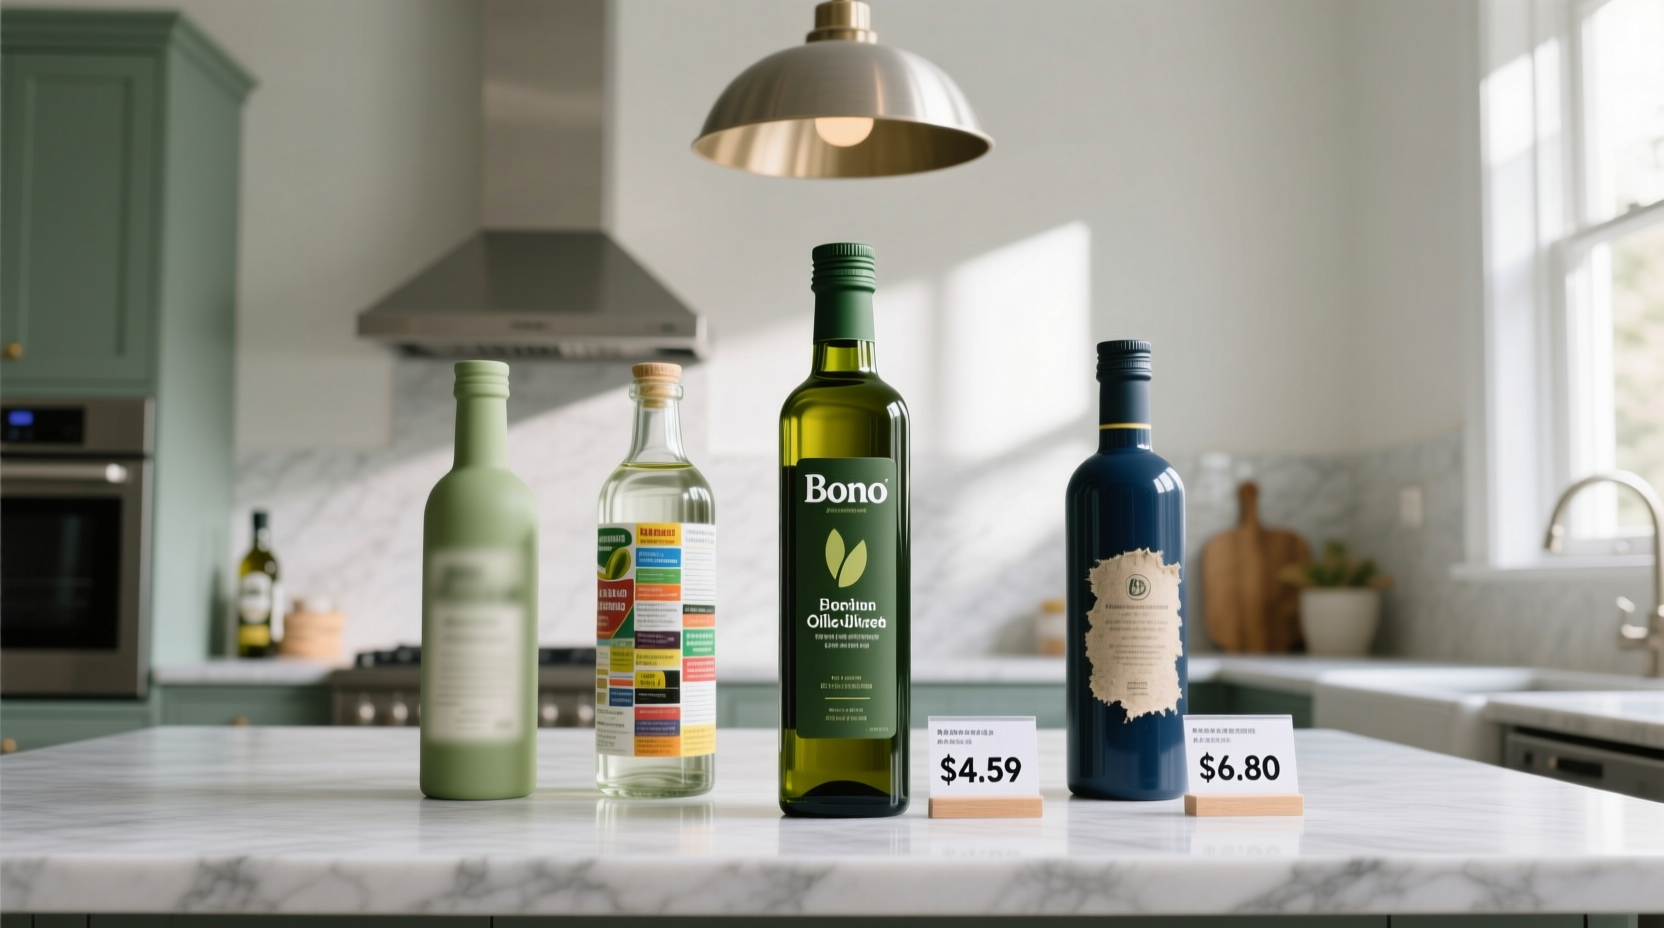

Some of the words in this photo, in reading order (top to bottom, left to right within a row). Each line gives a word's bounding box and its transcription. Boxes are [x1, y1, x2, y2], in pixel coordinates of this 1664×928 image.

[804, 473, 888, 504] Bono
[940, 753, 1022, 786] $4.59
[1199, 751, 1280, 783] $6.80
